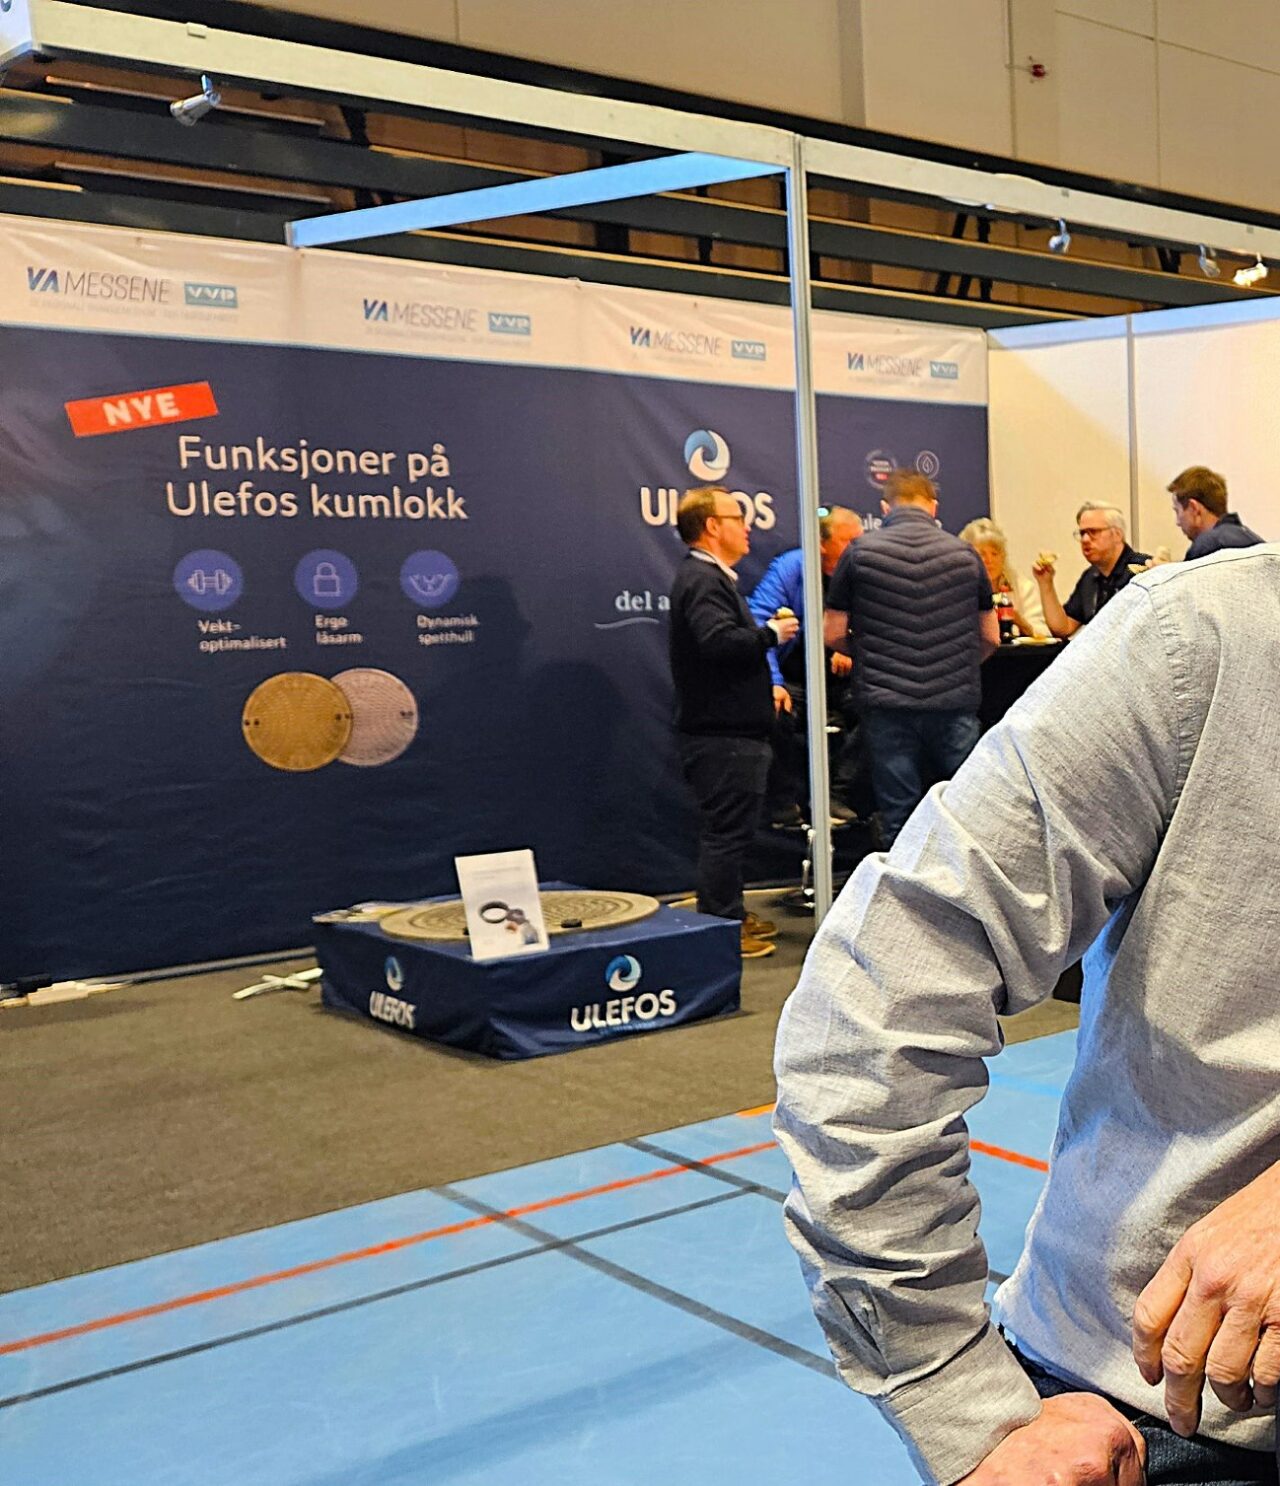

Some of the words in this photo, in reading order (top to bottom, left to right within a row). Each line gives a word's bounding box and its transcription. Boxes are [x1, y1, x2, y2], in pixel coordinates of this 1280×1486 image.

[63, 270, 172, 303] MESSENE
[186, 284, 237, 302] VVP
[391, 301, 480, 332] MESSENE
[490, 314, 531, 329] VVP
[652, 330, 722, 357] MESSENE
[732, 341, 765, 357] VVP
[102, 391, 180, 427] NYE
[178, 434, 397, 480] Funksjoner
[407, 443, 451, 484] på
[166, 481, 299, 519] Ulefos
[311, 482, 469, 520] kumlokk
[640, 486, 776, 530] ULOS
[615, 590, 653, 611] del
[198, 619, 241, 634] Vekt-
[314, 614, 348, 630] Ergo
[416, 614, 480, 633] Dynamisk
[199, 635, 287, 654] optimalisert
[369, 990, 418, 1030] ULEFOS
[570, 989, 677, 1033] ULEFOS
